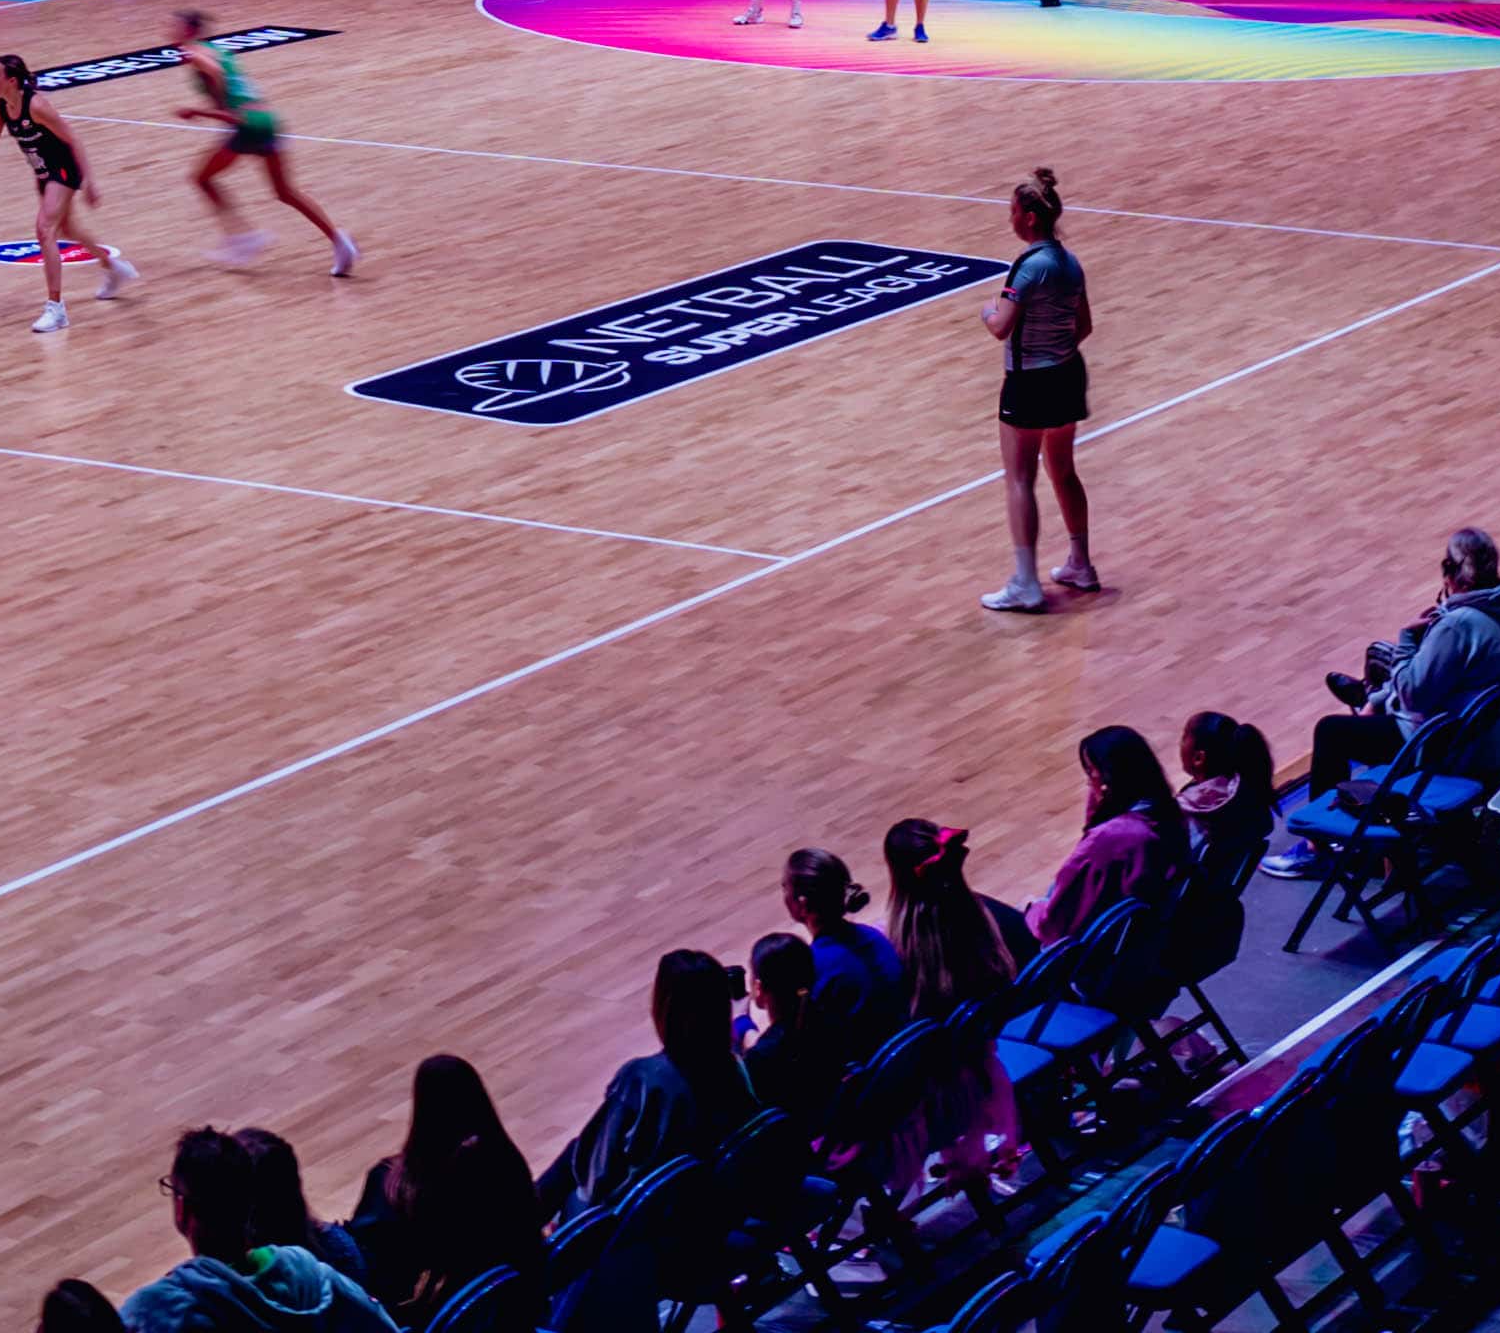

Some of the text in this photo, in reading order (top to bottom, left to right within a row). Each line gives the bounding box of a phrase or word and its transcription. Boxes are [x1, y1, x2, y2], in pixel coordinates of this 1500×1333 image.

[547, 254, 910, 355] NETBALL
[643, 261, 969, 365] SUPER LEAGUE
